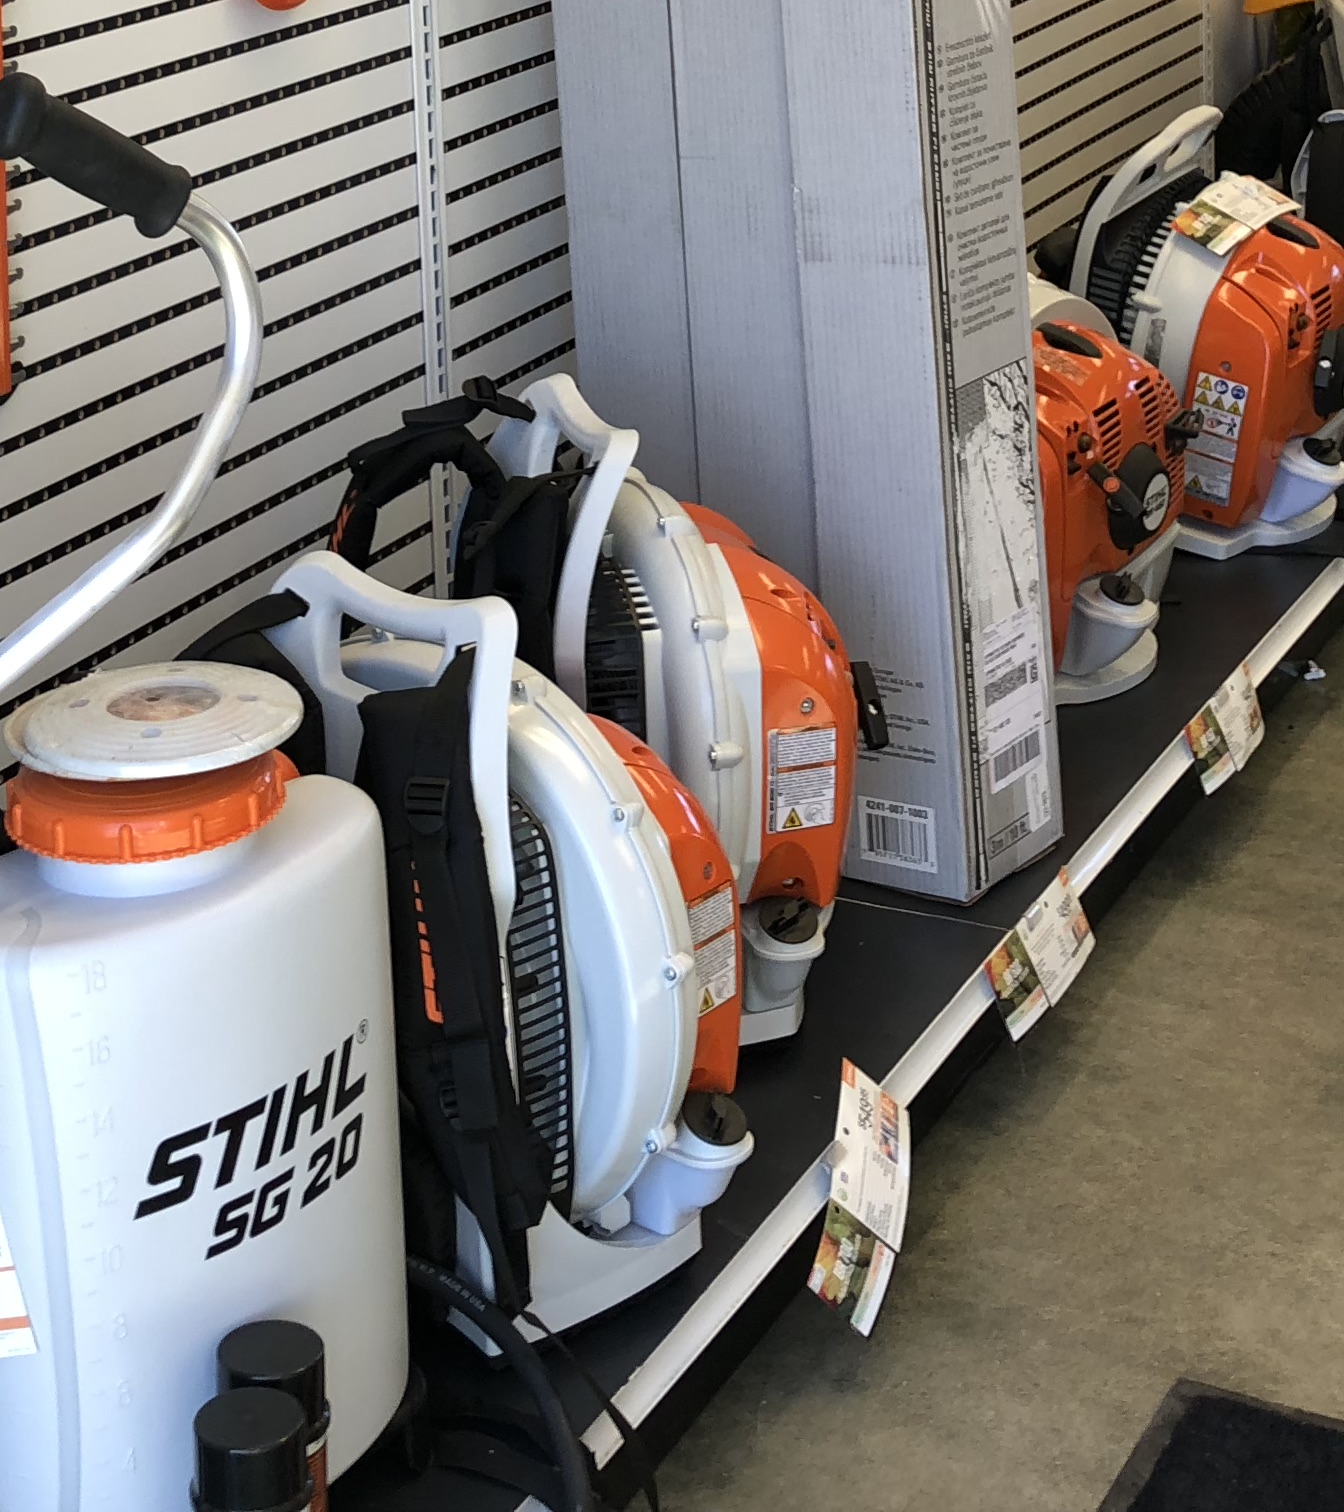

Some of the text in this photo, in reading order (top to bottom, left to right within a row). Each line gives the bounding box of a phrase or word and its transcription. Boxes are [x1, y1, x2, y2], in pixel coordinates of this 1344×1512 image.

[82, 961, 106, 993] 18
[88, 1035, 111, 1065] 16
[133, 1032, 367, 1221] STIHL
[204, 1112, 364, 1261] SG 20
